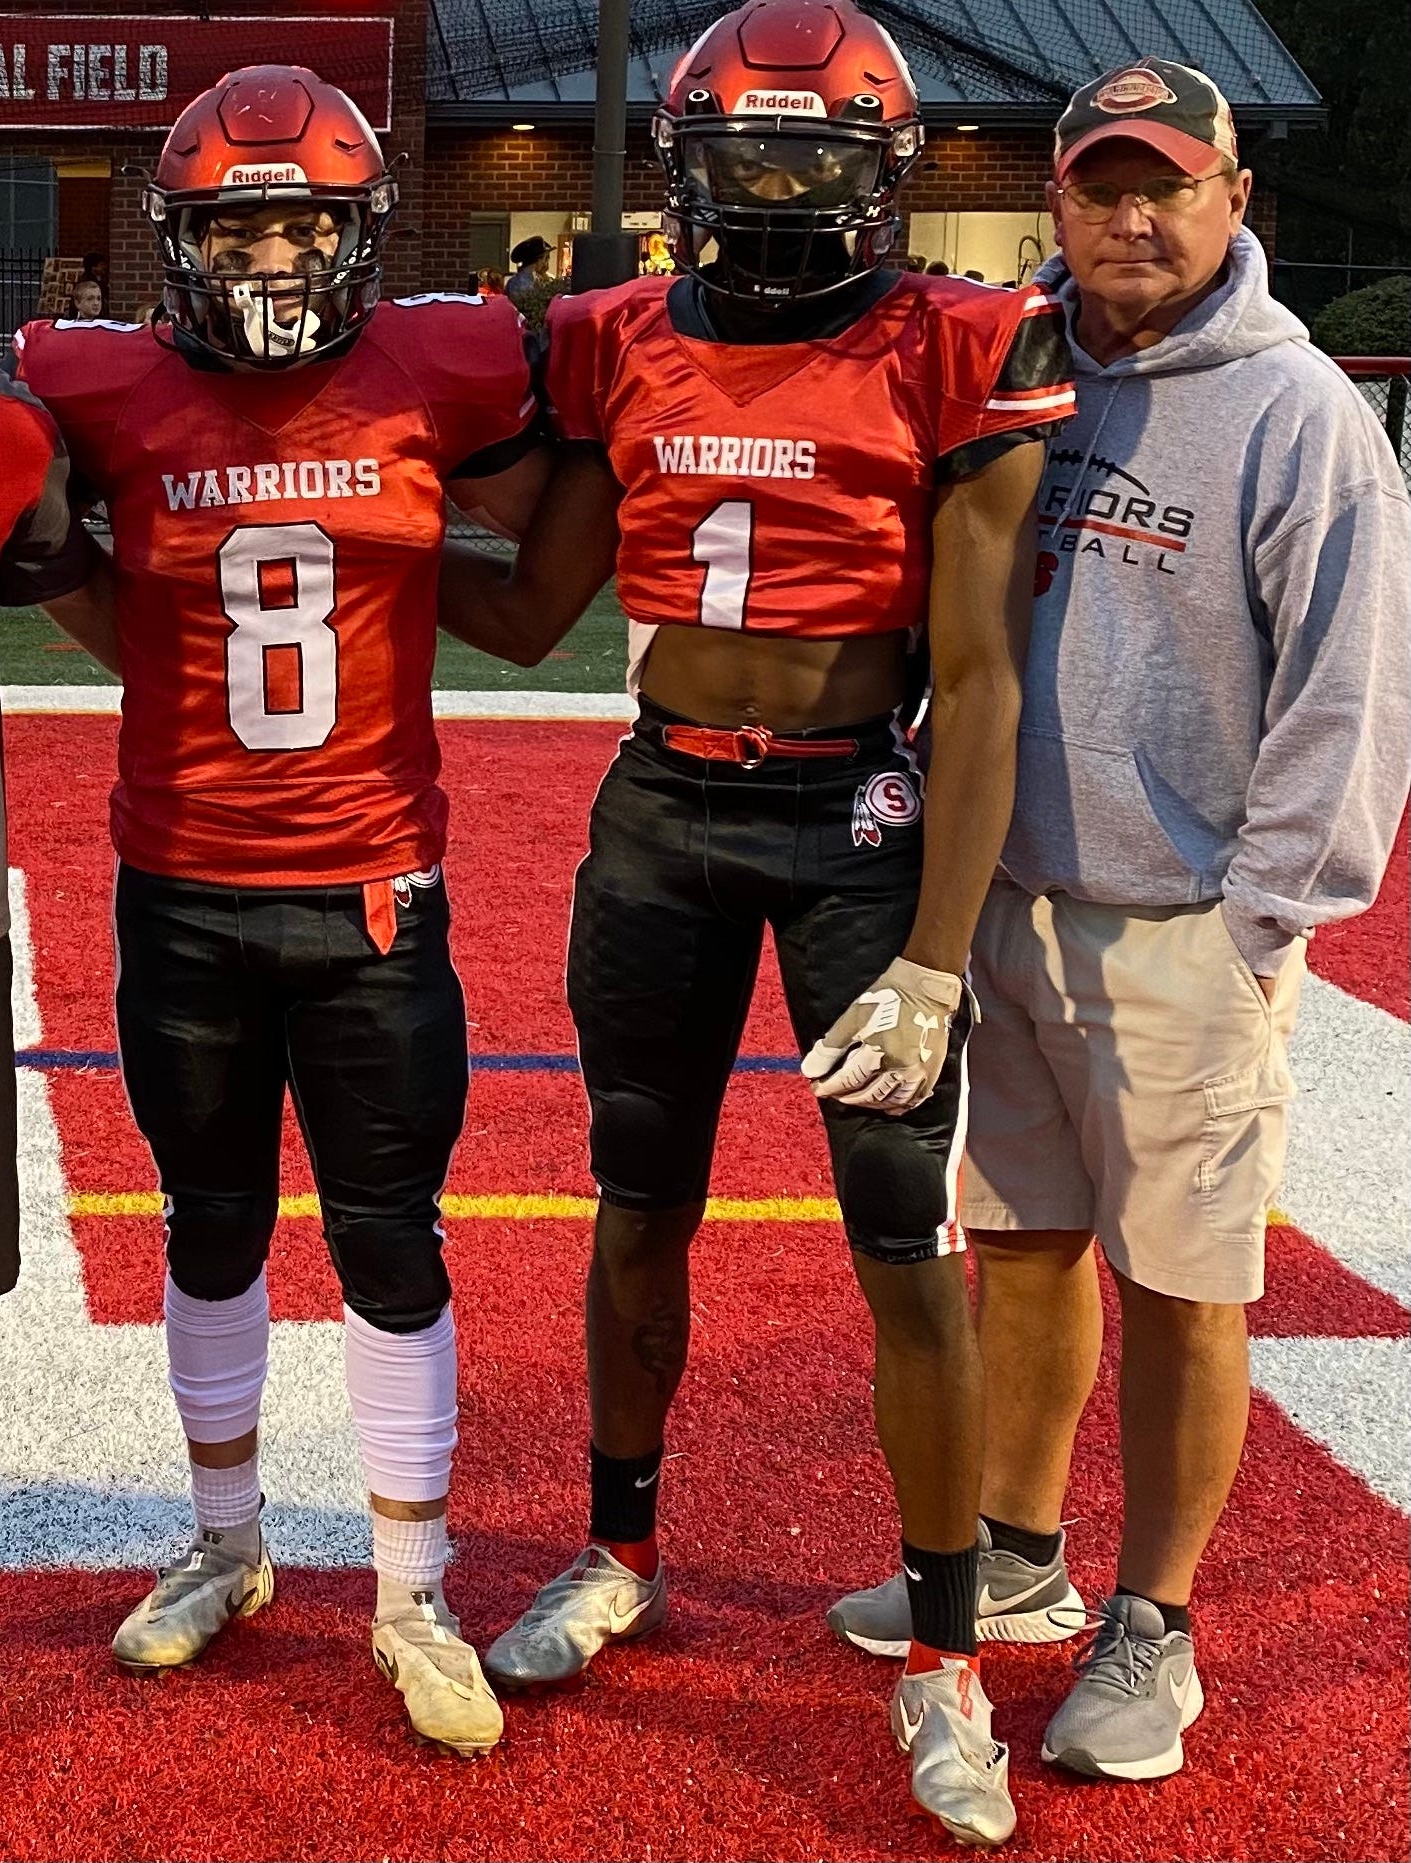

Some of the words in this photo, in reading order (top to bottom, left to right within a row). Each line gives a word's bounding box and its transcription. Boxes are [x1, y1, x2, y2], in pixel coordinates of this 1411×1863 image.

[47, 44, 168, 100] FIELD
[745, 94, 815, 110] Riddell
[232, 169, 296, 183] Riddell
[161, 457, 381, 511] WARRIORS
[653, 435, 816, 480] WARRIORS
[1045, 485, 1195, 538] RIORS
[691, 499, 754, 630] 1
[217, 520, 338, 752] 8
